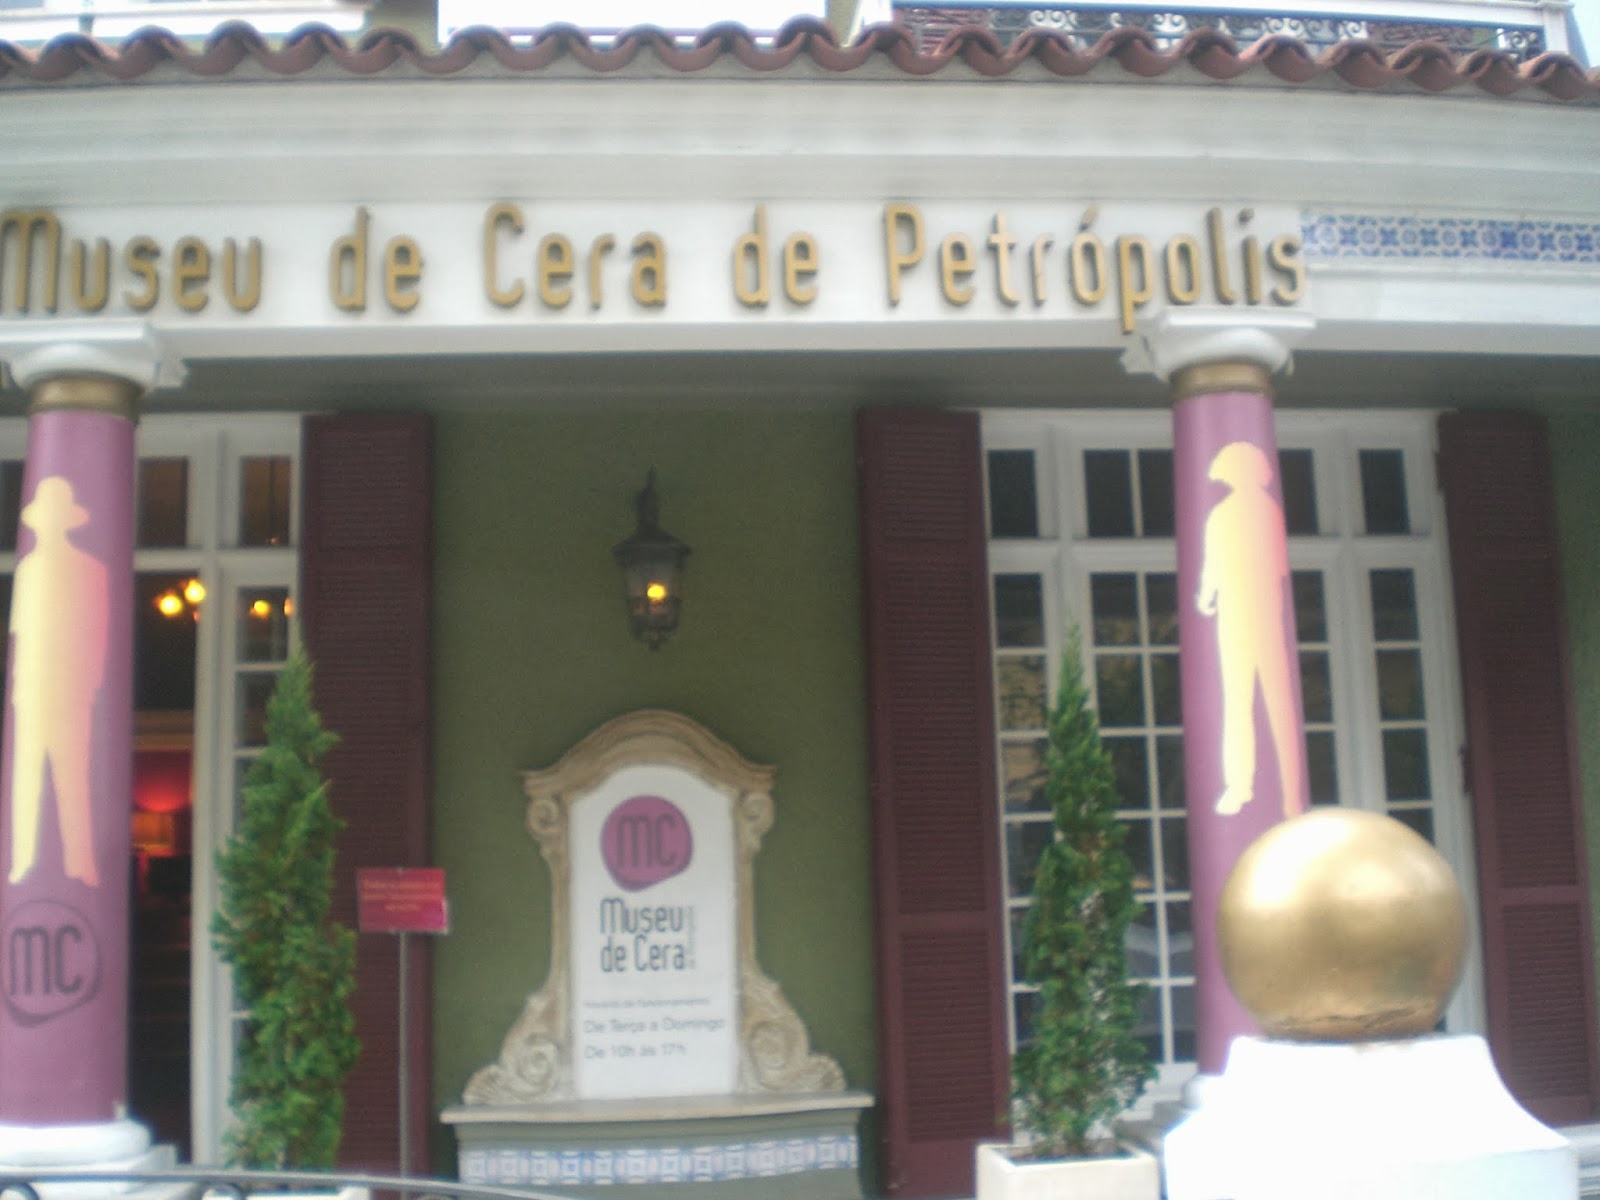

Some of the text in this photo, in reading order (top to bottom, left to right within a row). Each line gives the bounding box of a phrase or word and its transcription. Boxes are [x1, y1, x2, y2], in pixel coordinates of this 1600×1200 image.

[0, 202, 1306, 334] Museu de Cera de Petrópolis
[600, 897, 684, 934] Museu
[600, 936, 626, 973] de
[634, 933, 686, 972] Cera
